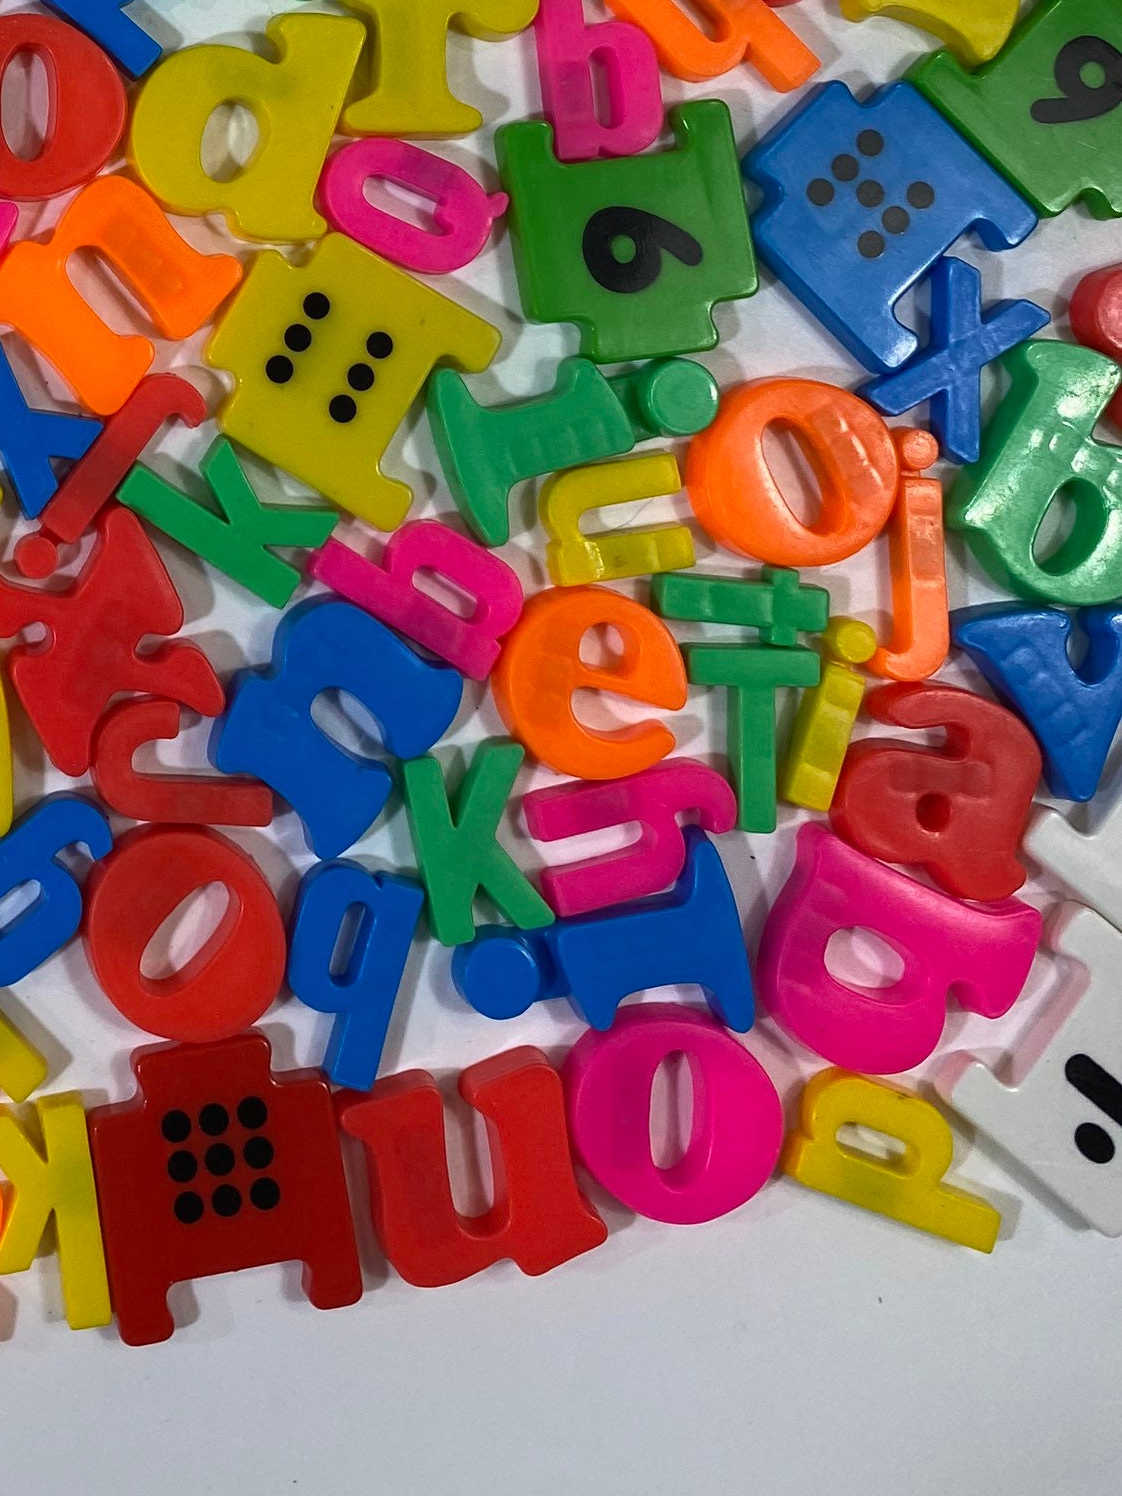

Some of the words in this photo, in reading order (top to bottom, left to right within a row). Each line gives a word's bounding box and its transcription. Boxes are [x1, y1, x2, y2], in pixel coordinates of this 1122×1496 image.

[684, 375, 900, 569] o
[490, 581, 690, 781] e
[678, 641, 823, 836] T
[783, 614, 880, 814] i
[399, 734, 557, 949] K
[828, 681, 1045, 906] a
[86, 827, 288, 1044] o
[286, 857, 426, 1094] q
[331, 1044, 610, 1290] u
[561, 1001, 784, 1226] o
